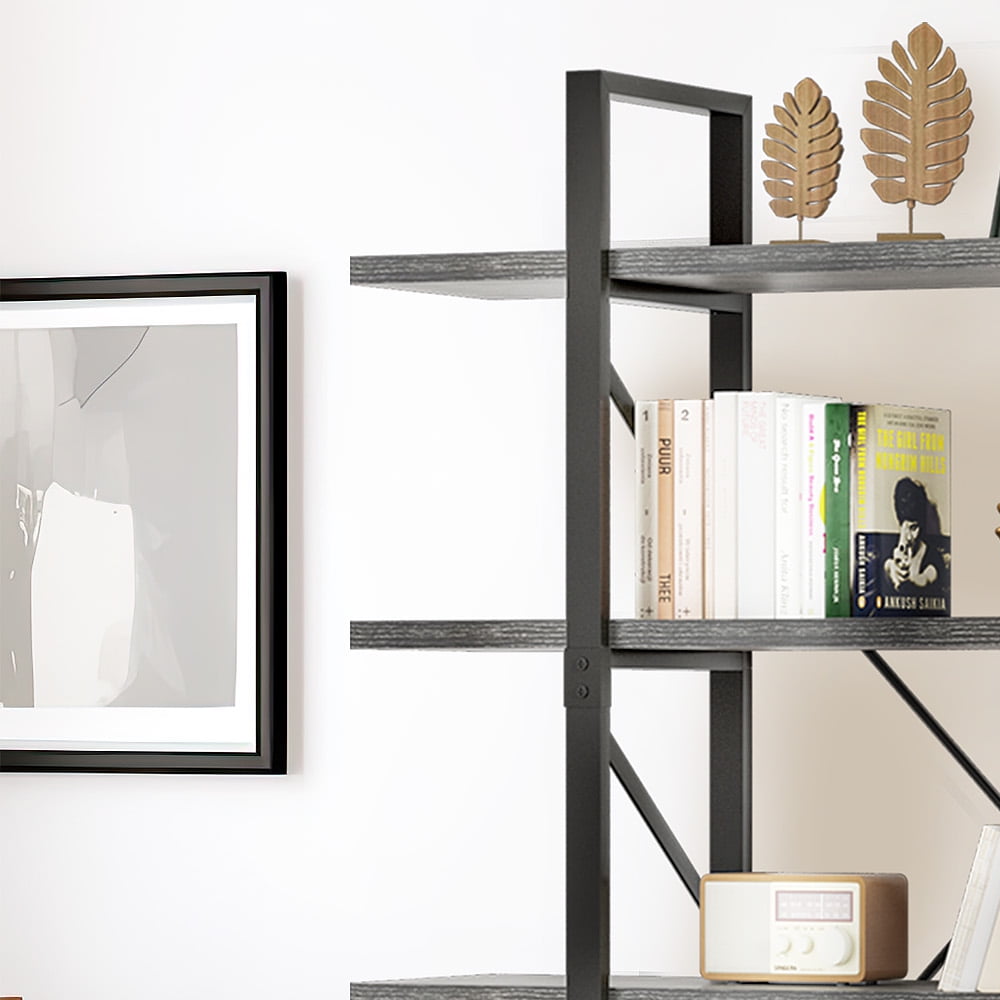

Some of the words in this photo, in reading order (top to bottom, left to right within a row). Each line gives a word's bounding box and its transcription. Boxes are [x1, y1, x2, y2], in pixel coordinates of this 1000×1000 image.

[681, 409, 690, 422] 2
[877, 428, 894, 448] THE
[896, 430, 917, 450] GIRL
[920, 432, 945, 452] FROM
[658, 438, 671, 476] PUUR
[920, 455, 946, 474] HILLS
[658, 574, 671, 603] THEE
[884, 596, 917, 609] ANKUSH
[919, 597, 946, 610] SAIKIA
